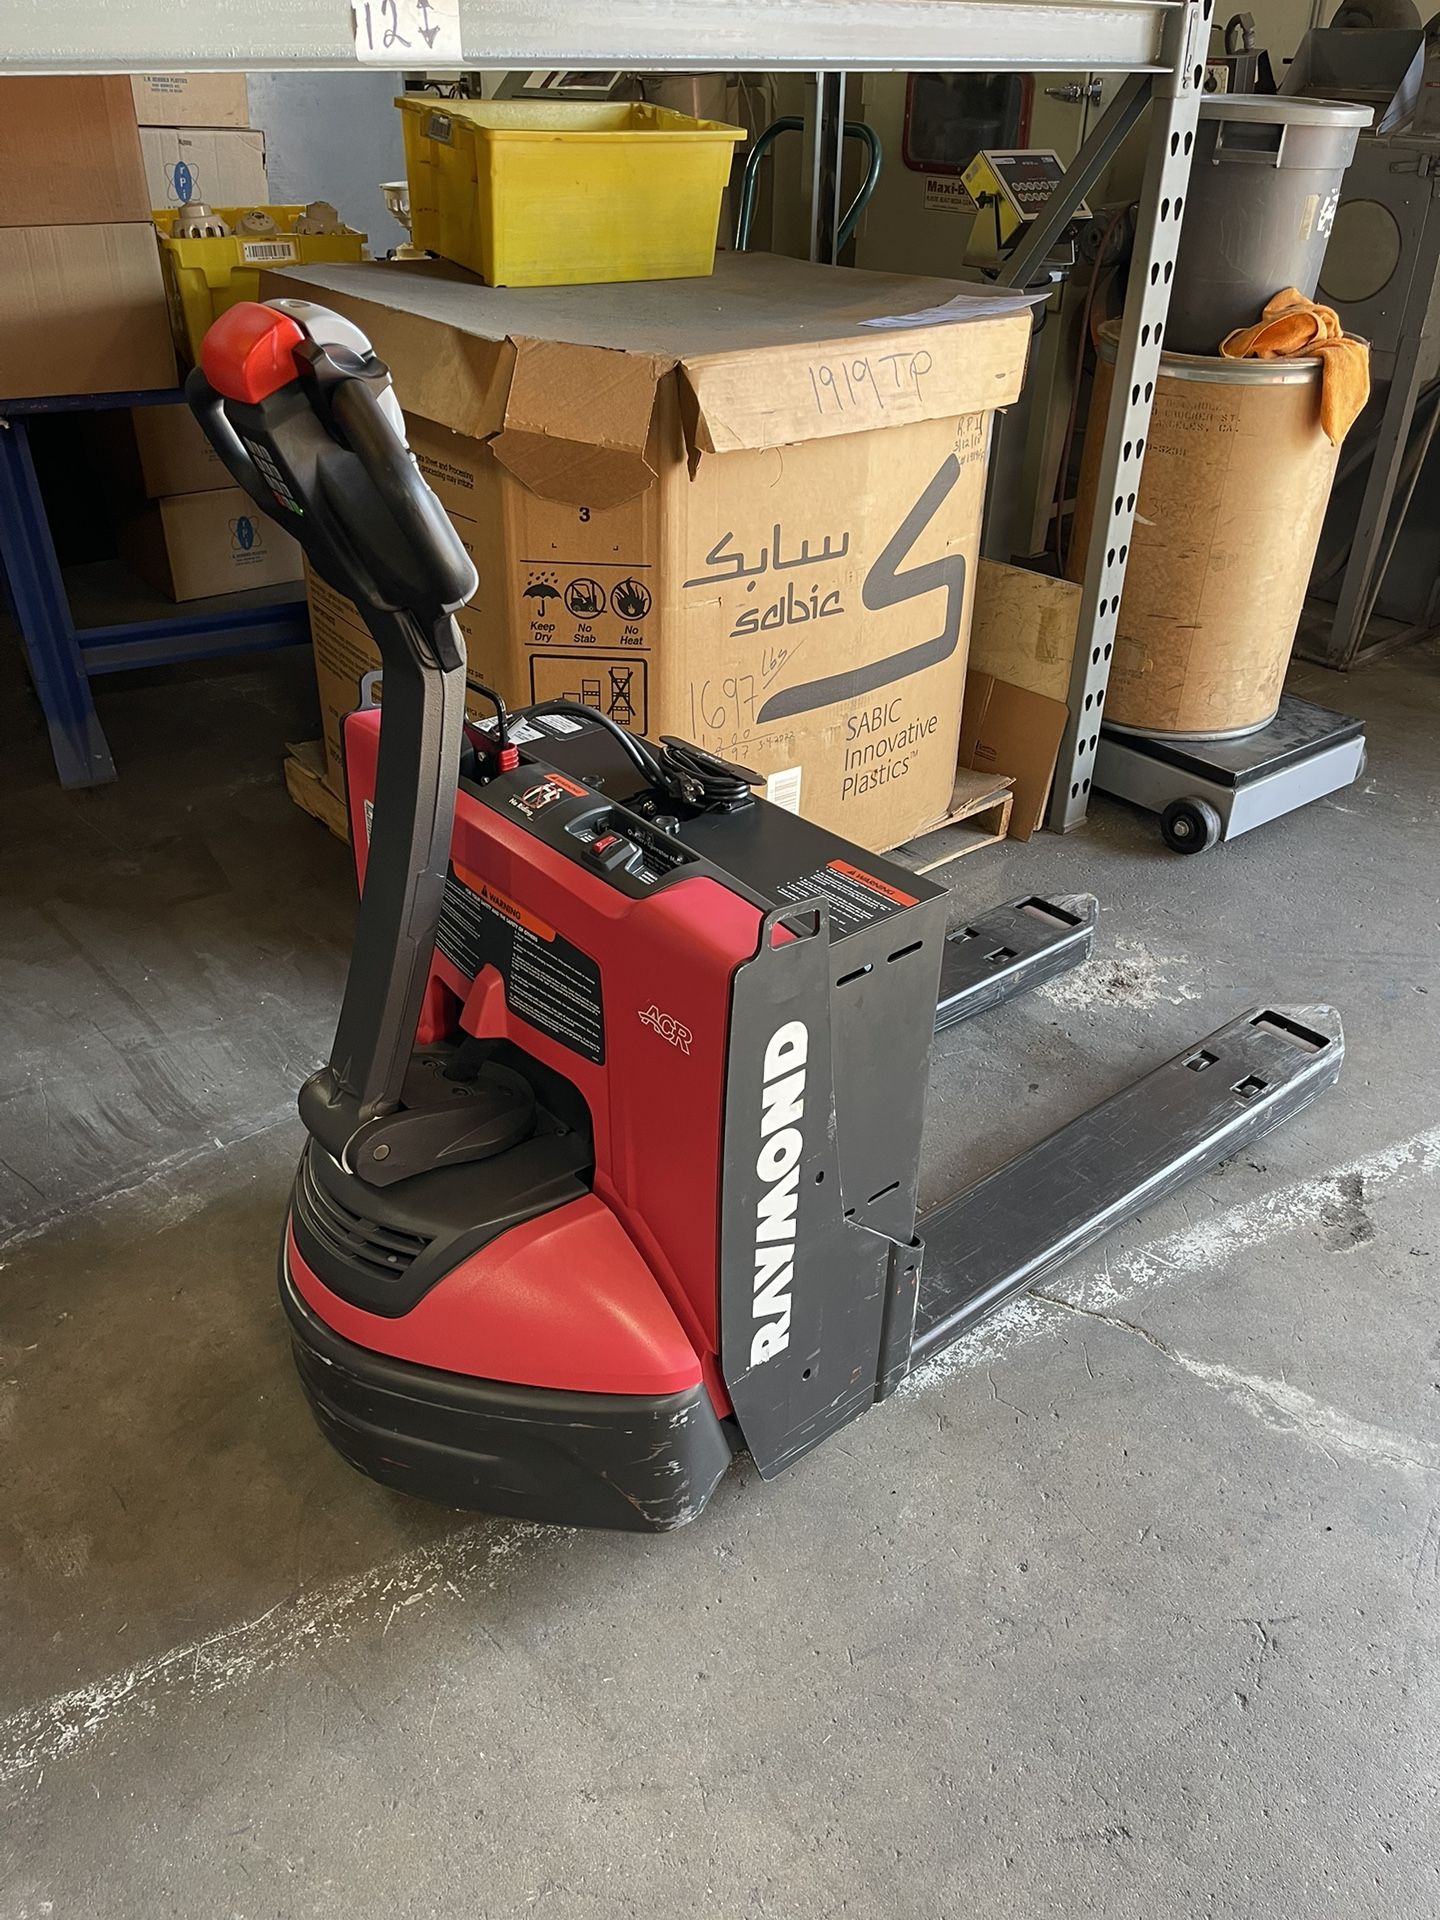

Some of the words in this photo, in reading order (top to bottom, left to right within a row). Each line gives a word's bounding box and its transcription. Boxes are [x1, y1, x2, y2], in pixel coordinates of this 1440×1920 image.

[364, 0, 412, 50] 12
[927, 180, 968, 196] Maxi-B
[579, 508, 591, 522] 3
[729, 582, 845, 638] sabic
[530, 621, 555, 635] Keep
[534, 631, 552, 644] Dry
[573, 633, 597, 644] Stab
[577, 623, 592, 633] No
[624, 625, 639, 635] No
[619, 635, 643, 645] Heat
[690, 675, 758, 739] 1697
[846, 698, 902, 742] SABIC
[844, 713, 939, 772] Innovative
[856, 873, 895, 896] WARNING
[489, 891, 521, 920] WARNING
[638, 1005, 693, 1055] ACR
[750, 1020, 809, 1370] RAYMOND
